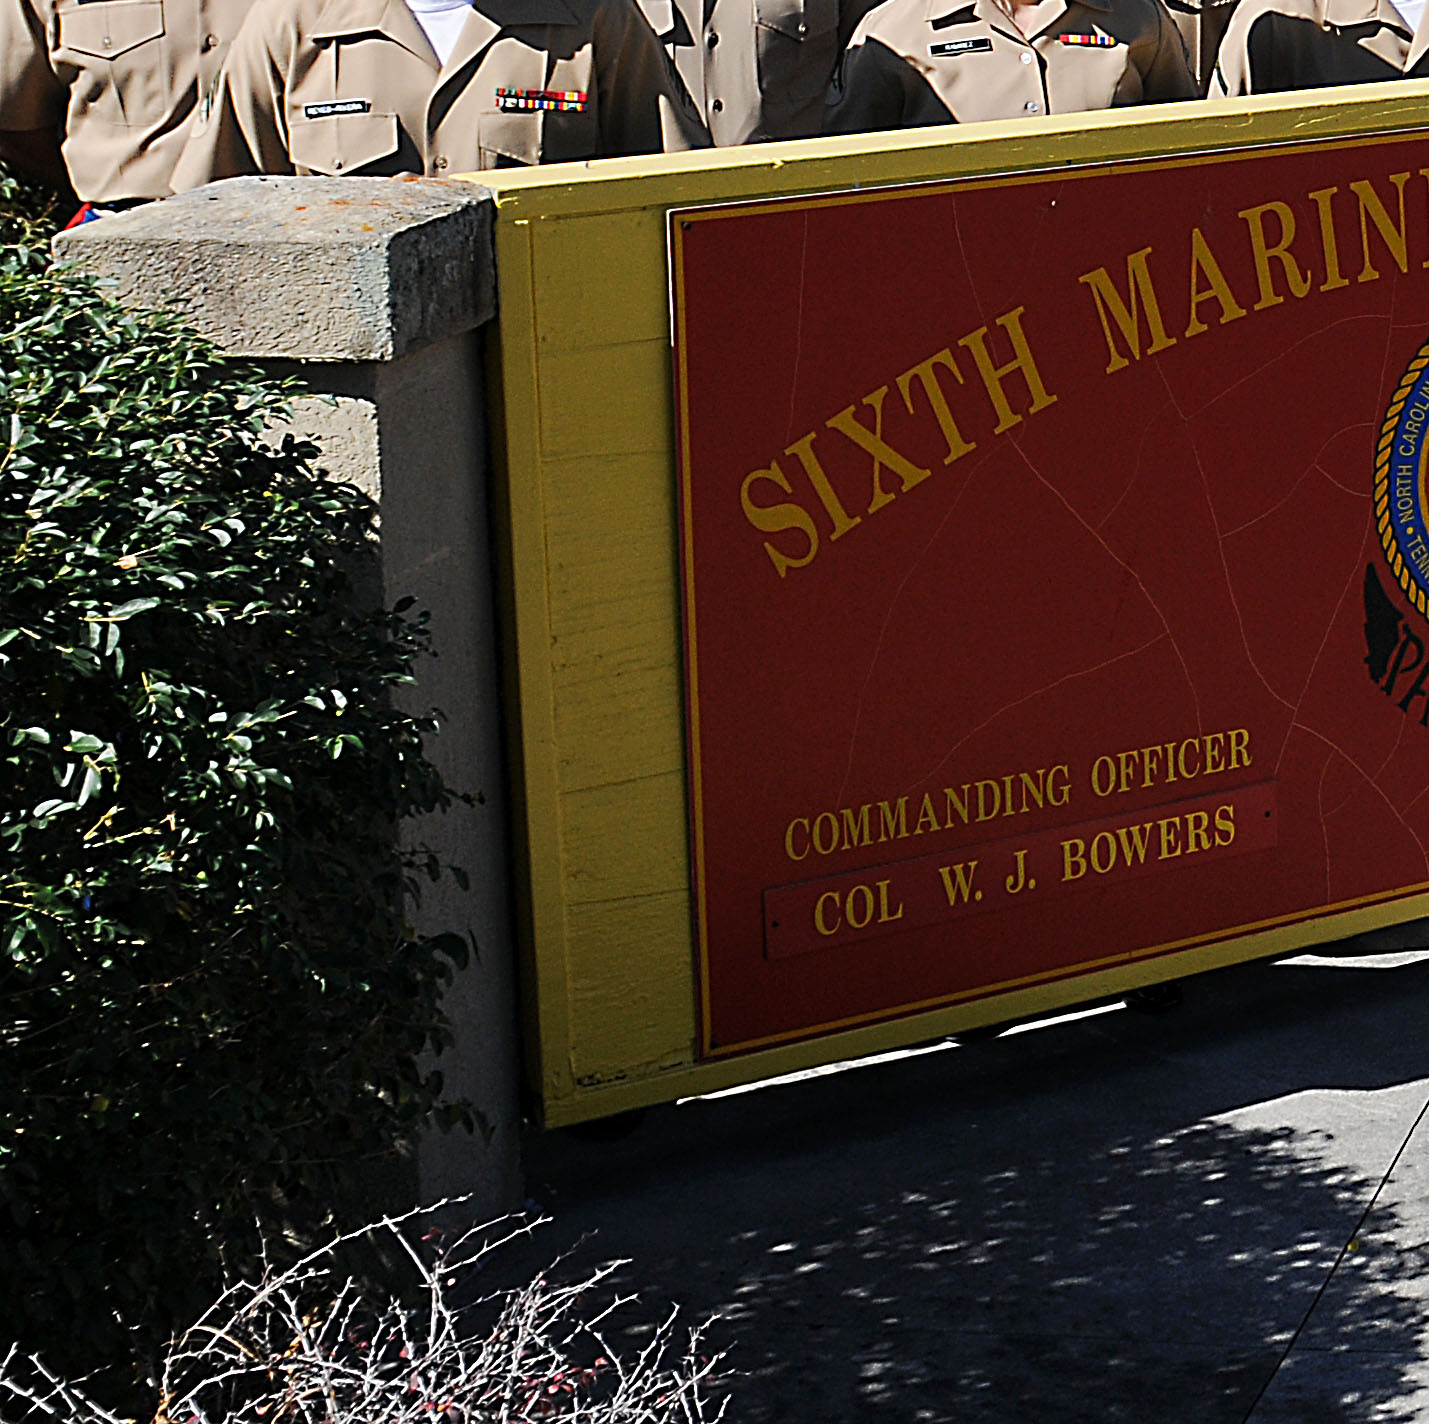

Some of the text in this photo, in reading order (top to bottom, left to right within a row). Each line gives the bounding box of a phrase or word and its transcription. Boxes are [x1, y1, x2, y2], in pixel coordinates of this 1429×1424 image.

[739, 306, 1058, 578] SIXTH
[1396, 464, 1415, 524] NORTH
[784, 728, 1253, 861] COMMANDING OFFICER
[814, 805, 1237, 935] COL W. J. BOWERS
